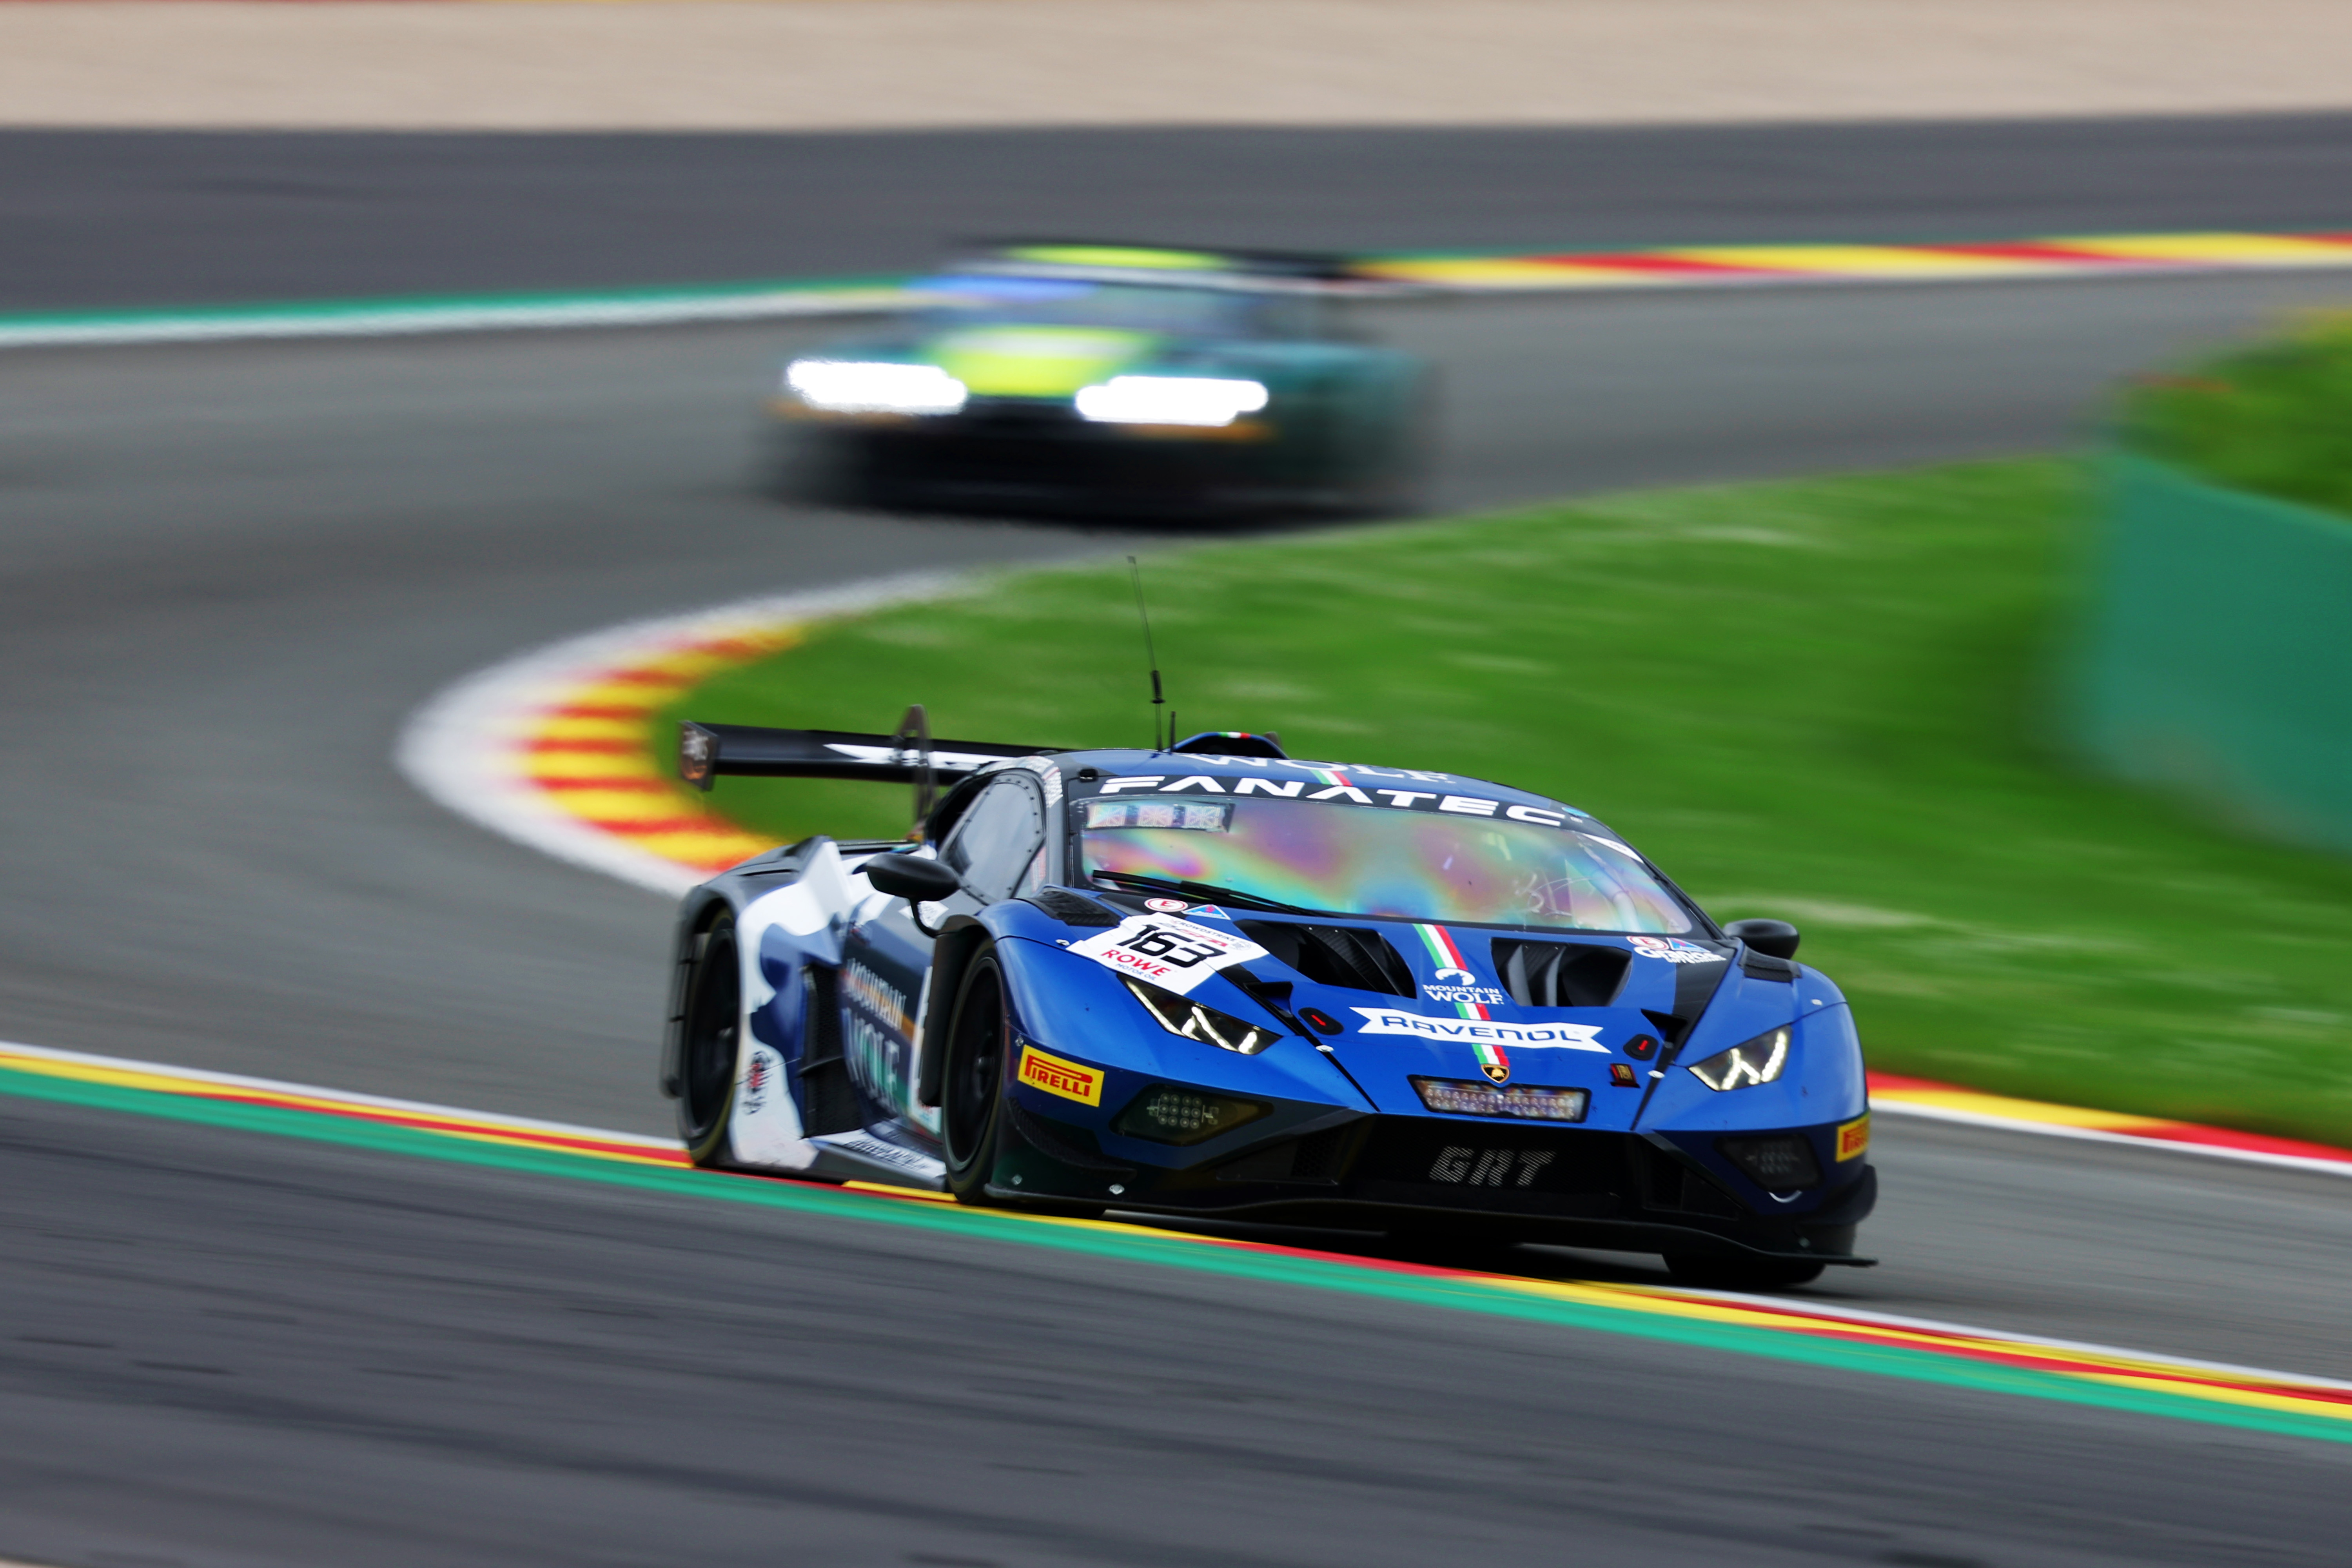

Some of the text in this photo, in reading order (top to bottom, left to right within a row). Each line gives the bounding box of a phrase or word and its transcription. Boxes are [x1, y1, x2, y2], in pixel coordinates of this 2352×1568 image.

[1099, 776, 1566, 826] FANATEC
[1175, 920, 1237, 942] CROWDSTRIKE
[1116, 924, 1227, 968] 163
[1101, 949, 1172, 976] ROWE
[1115, 963, 1144, 975] MOTOR
[1422, 984, 1500, 994] MOUNTAIN
[1425, 990, 1504, 1004] WOLF
[1380, 1016, 1583, 1042] RAVENOL
[1024, 1054, 1093, 1097] PIRELLI
[1429, 1145, 1557, 1187] GRT
